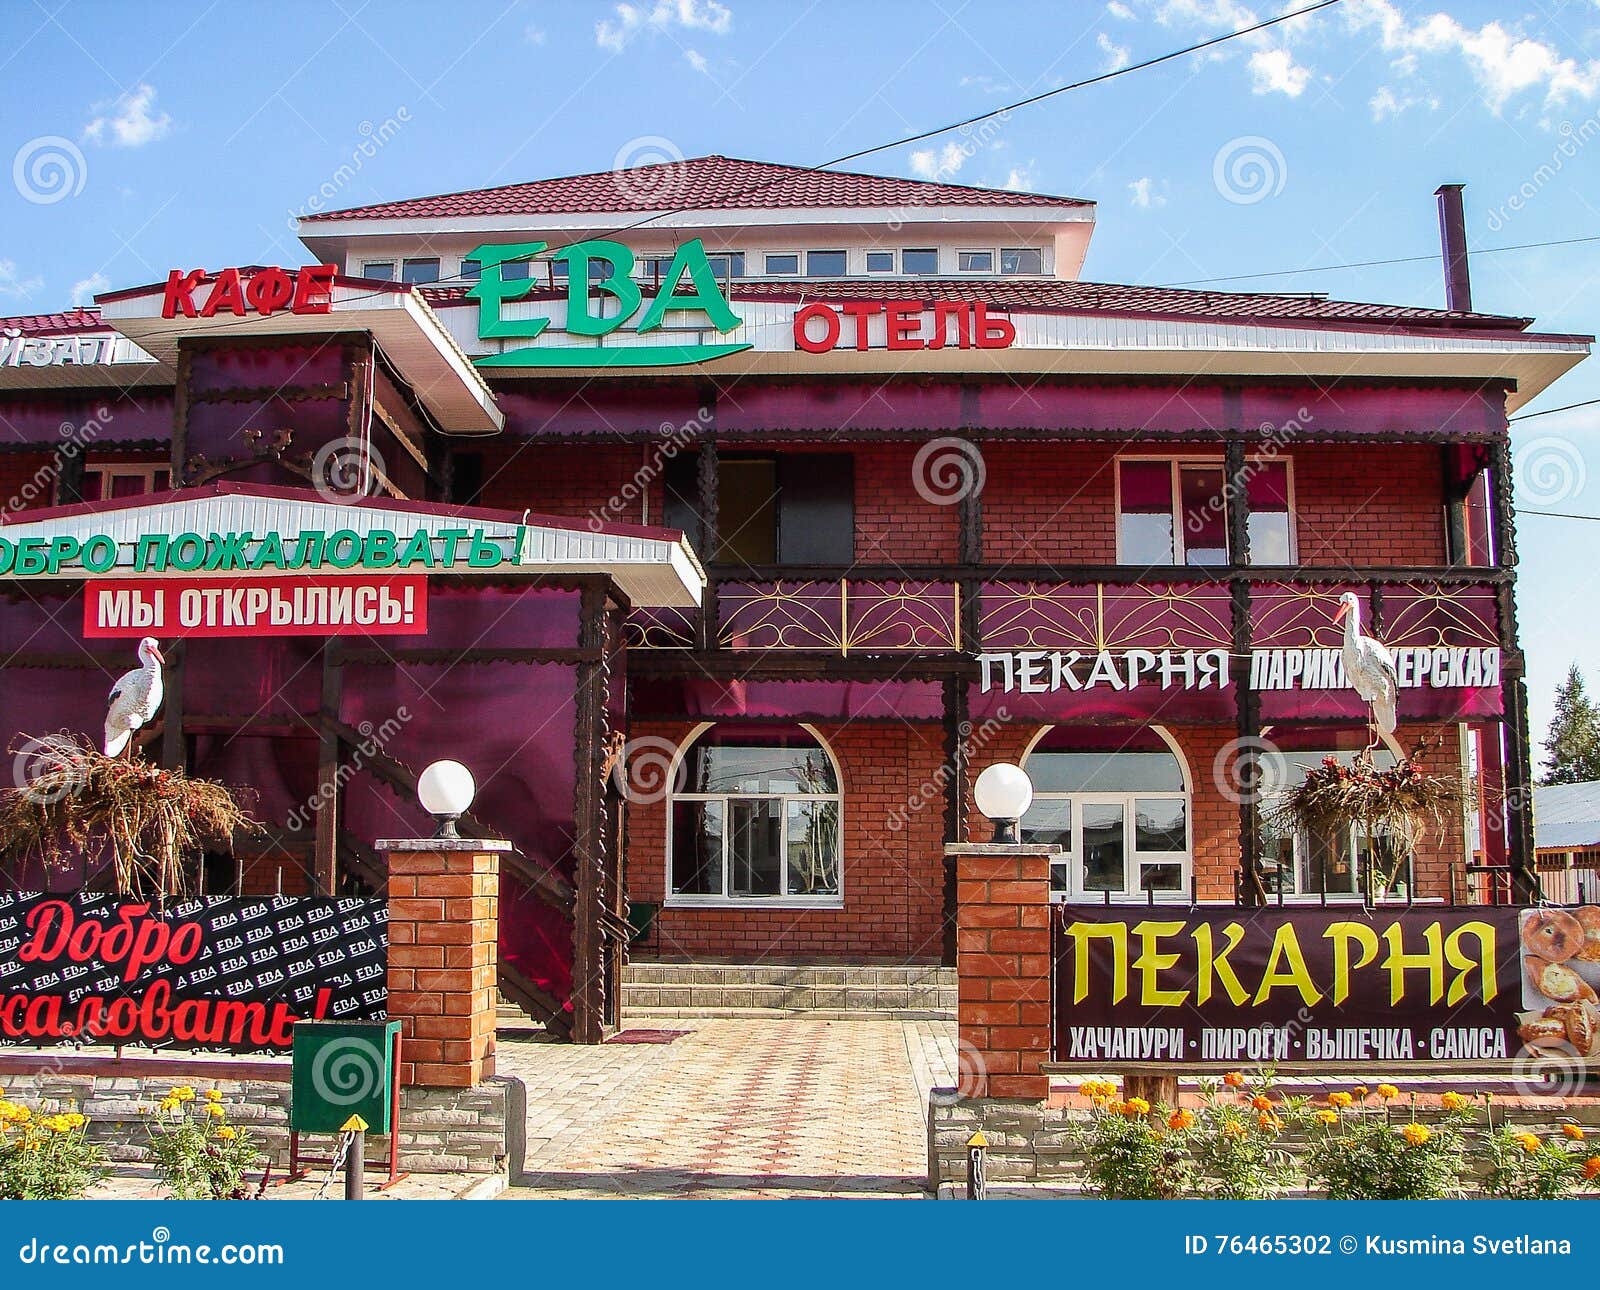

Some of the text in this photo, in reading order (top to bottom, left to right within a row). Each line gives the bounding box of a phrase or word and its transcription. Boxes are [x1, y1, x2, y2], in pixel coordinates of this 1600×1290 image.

[161, 264, 338, 319] КАФЕ
[464, 238, 743, 340] ЕВА
[794, 300, 1016, 353] ОТЕЛЬ
[135, 526, 526, 573] ПОЖАЛОВАТЬ!
[98, 586, 414, 627] МЫ ОТКРЫЛИСЬ!
[975, 648, 1231, 694] ПЕКАРНЯ
[1249, 647, 1501, 690] ПАРИКЕРСКАЯ
[0, 916, 18, 930] ВА
[176, 900, 203, 916] ЕВА
[211, 913, 238, 929] ЕВА
[241, 903, 268, 919] ЕВА
[217, 935, 243, 952] ЕВА
[246, 925, 273, 942] ЕВА
[277, 915, 304, 932] ЕВА
[306, 905, 334, 922] ЕВА
[19, 899, 202, 982] Добро
[190, 966, 217, 982] ЕВА
[221, 956, 248, 972] ЕВА
[251, 946, 278, 962] ЕВА
[282, 936, 309, 952] ЕВА
[311, 926, 339, 942] ЕВА
[342, 915, 370, 932] ЕВА
[33, 972, 60, 989] ЕВА
[227, 979, 254, 995] ЕВА
[257, 969, 284, 985] ЕВА
[288, 959, 315, 975] ЕВА
[318, 949, 346, 965] ЕВА
[349, 939, 377, 955] ЕВА
[294, 984, 316, 1000] ЕВ
[355, 963, 384, 980] ЕВА
[1064, 921, 1498, 1007] ПЕКАРНЯ
[333, 987, 388, 1013] ЕВА ЕВА
[1069, 1027, 1506, 1060] ХАЧАПУРИ ПИРОГИ ВЫПЕЧКА САМСА
